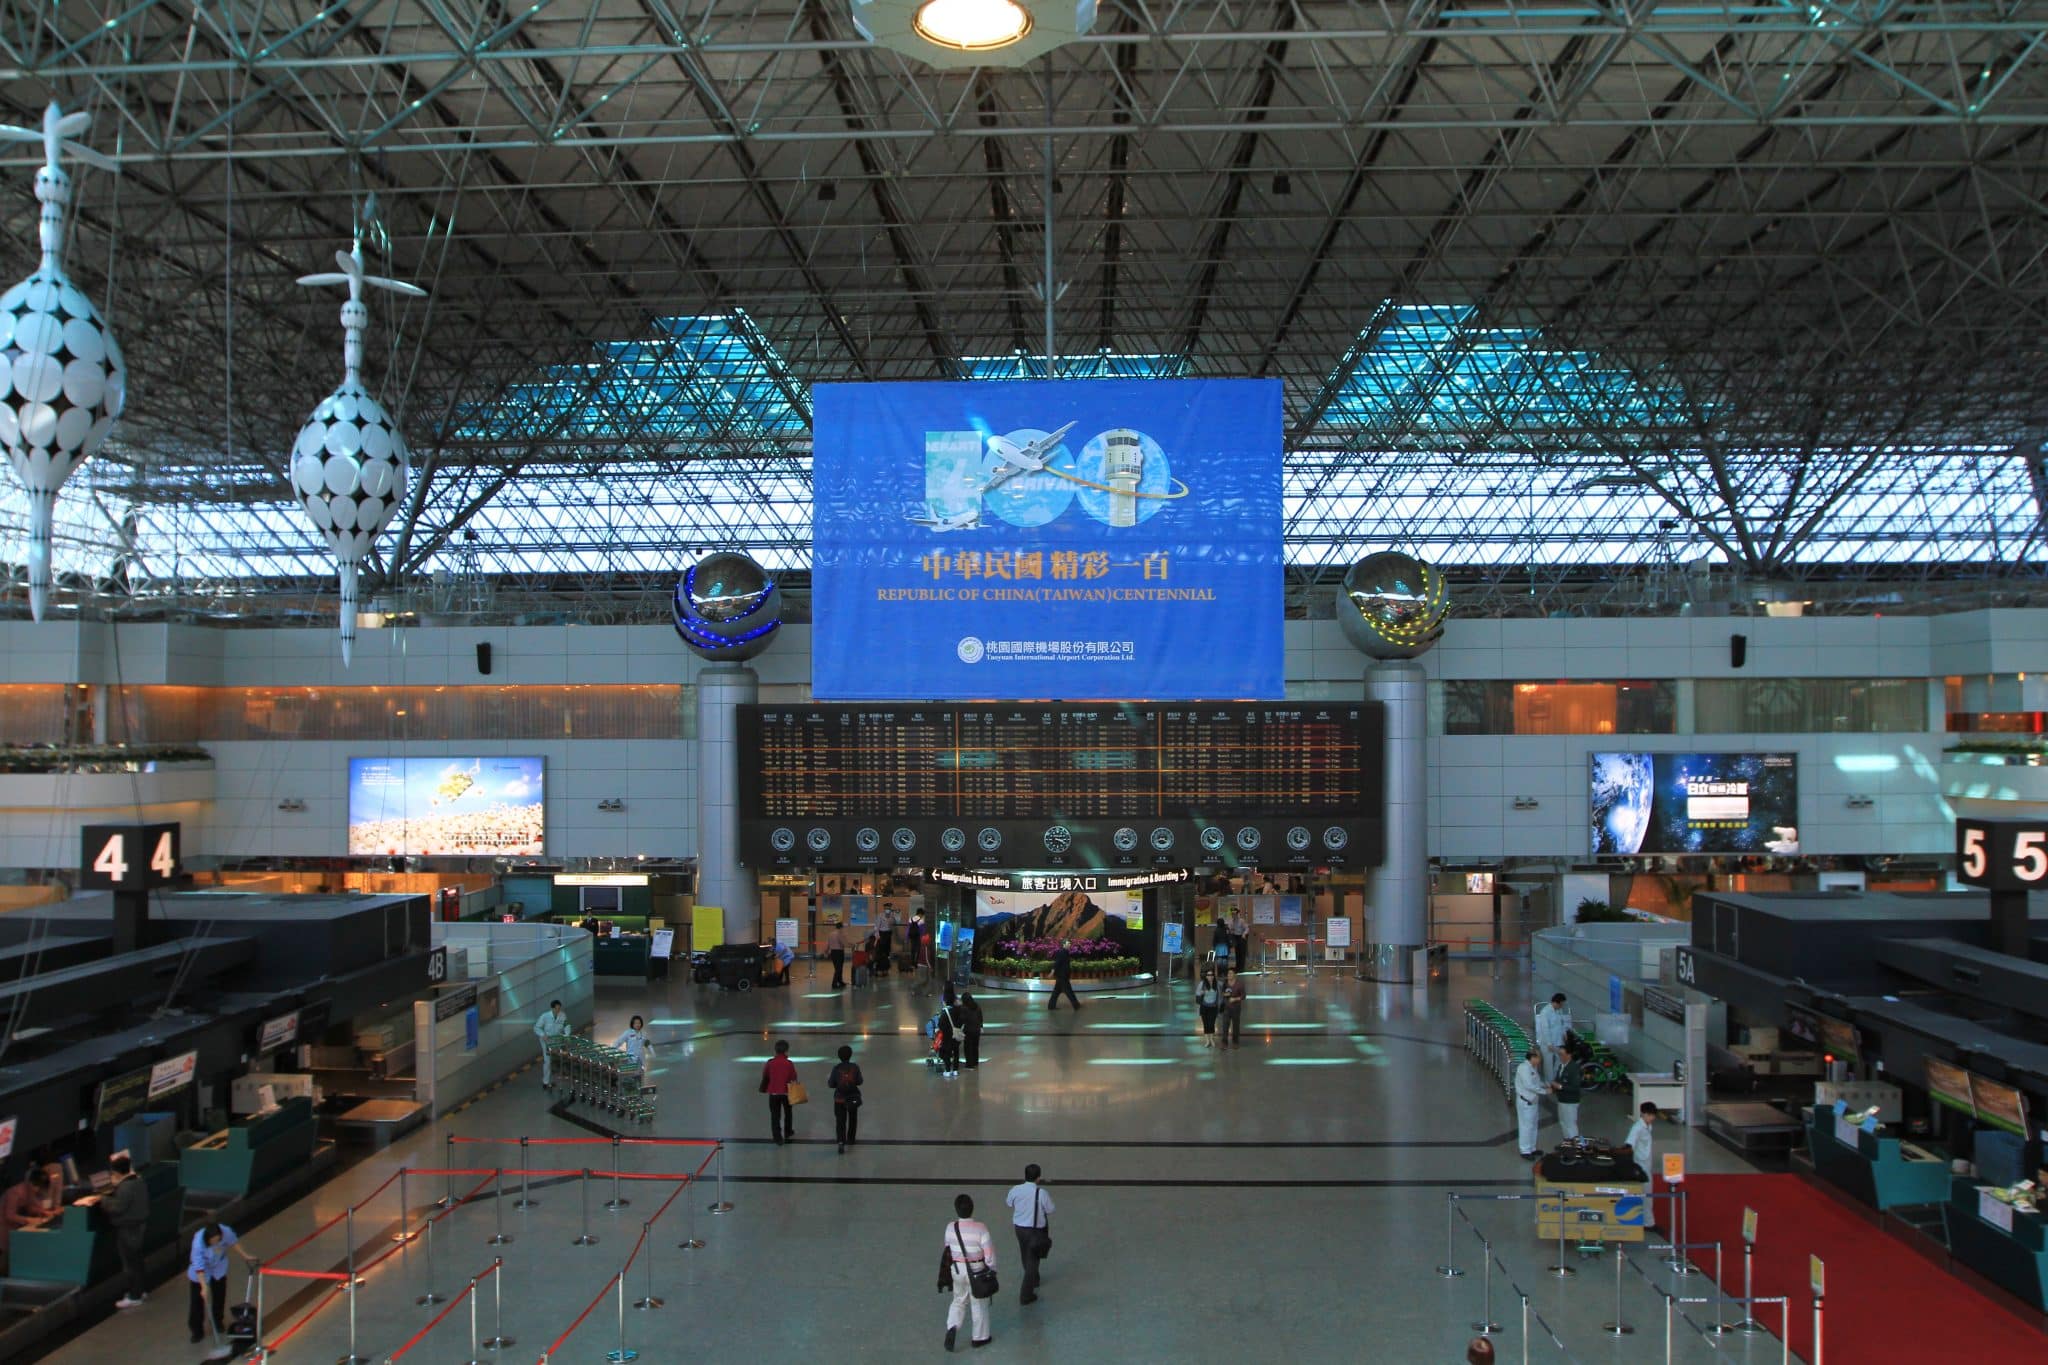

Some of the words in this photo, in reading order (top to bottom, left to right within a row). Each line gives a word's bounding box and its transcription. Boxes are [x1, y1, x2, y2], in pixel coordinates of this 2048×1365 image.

[923, 551, 1042, 580] 中華民國
[1050, 550, 1170, 580] 精彩一百
[877, 588, 955, 601] REPUBLIC
[958, 588, 980, 601] OF
[1014, 654, 1056, 662] International
[1056, 654, 1081, 662] Airport
[1081, 654, 1120, 662] Corporation
[93, 833, 129, 882] 4
[151, 831, 175, 878] 4
[1962, 828, 1986, 878] 5
[2012, 831, 2048, 881] 5
[977, 876, 1010, 889] Boarding
[1021, 877, 1097, 890] 旅客出境入口
[1107, 874, 1149, 888] Immigration
[1154, 871, 1179, 883] Boarding
[428, 952, 445, 980] 4B
[1680, 951, 1696, 984] 5A
